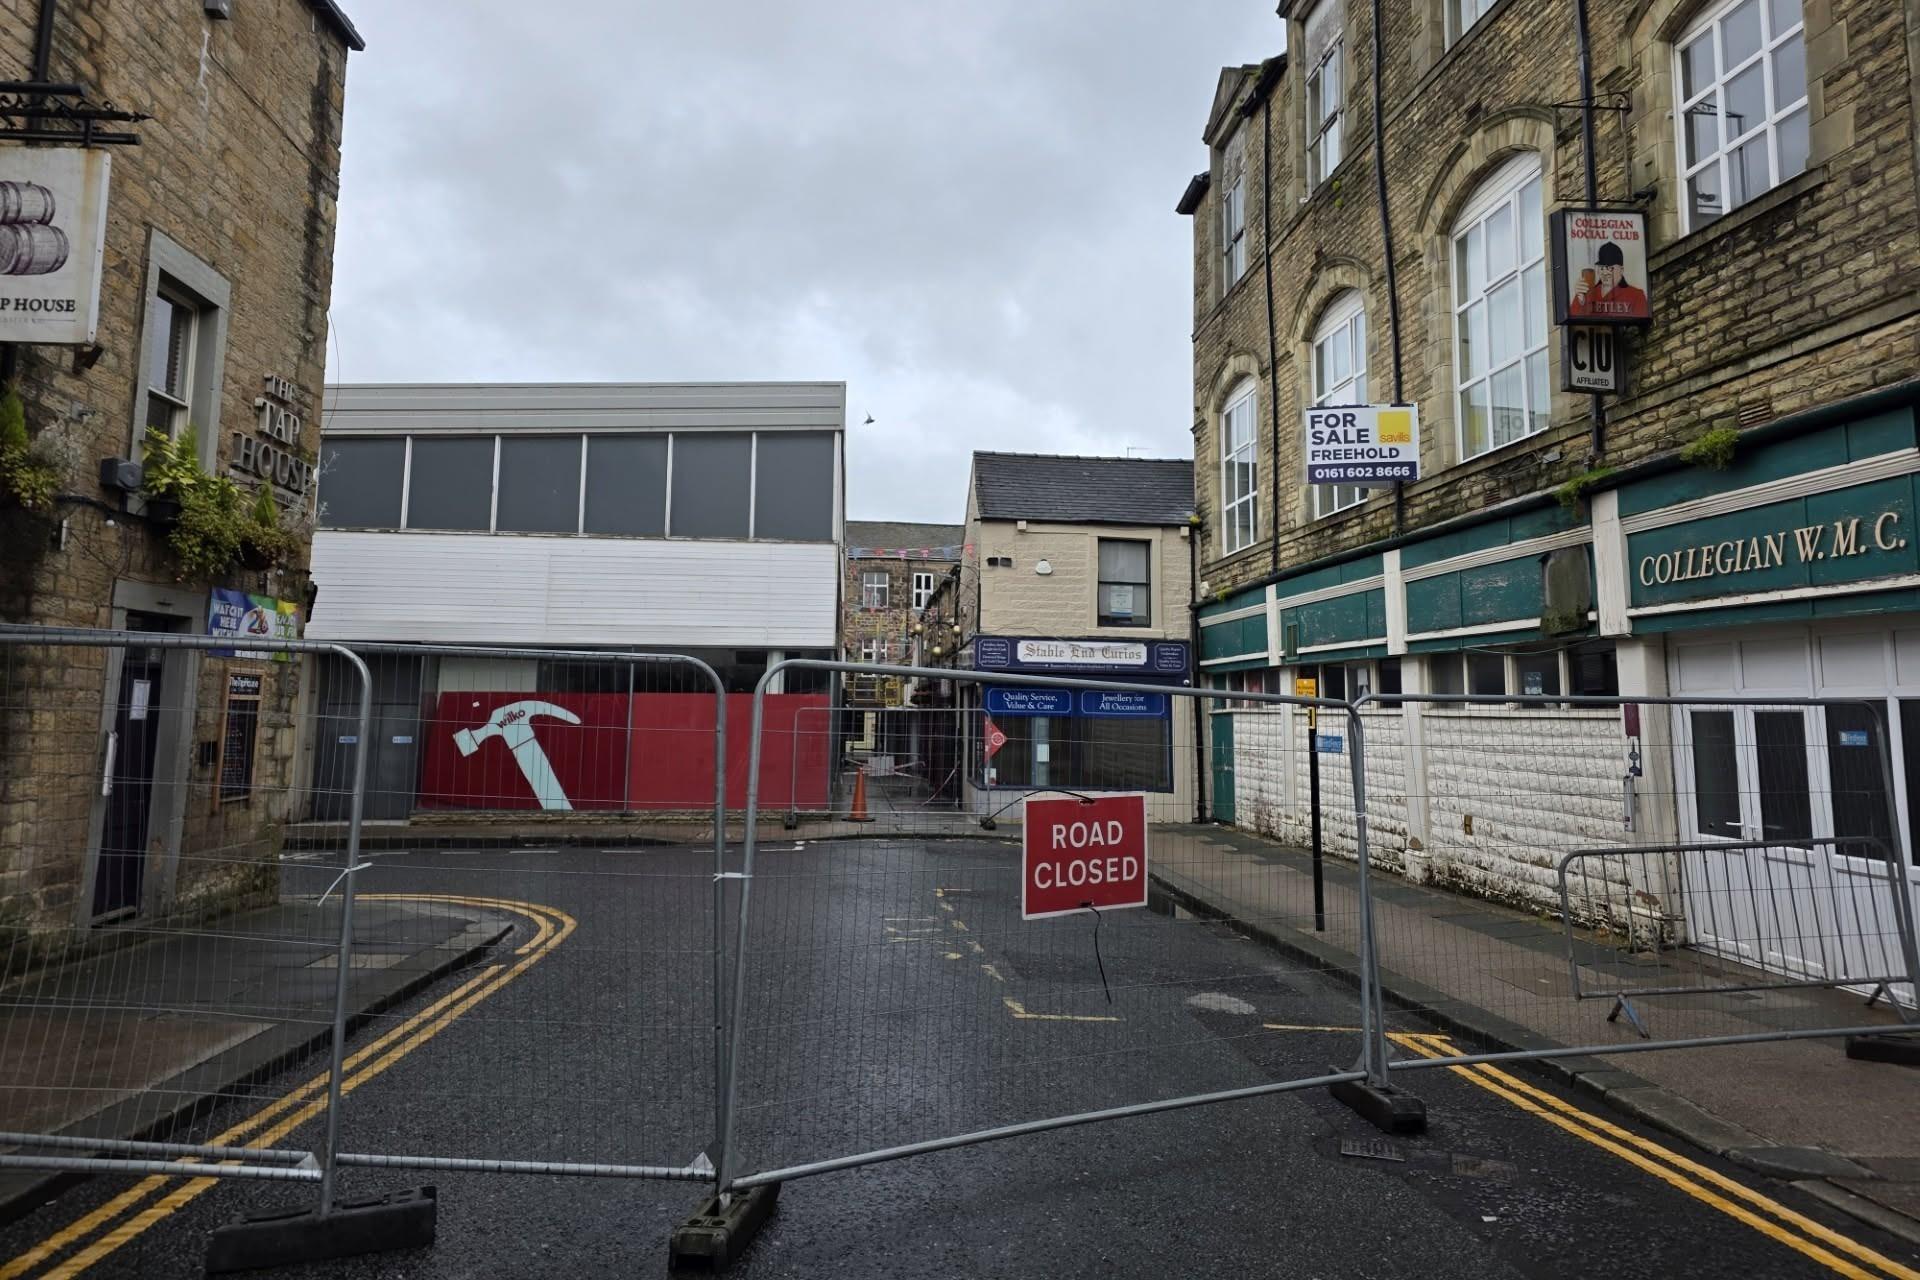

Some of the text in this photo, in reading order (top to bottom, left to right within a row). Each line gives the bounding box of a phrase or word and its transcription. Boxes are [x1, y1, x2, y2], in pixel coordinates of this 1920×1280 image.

[1576, 218, 1633, 229] COLLEGIAN
[1571, 229, 1639, 240] SOCIAL CLUB
[14, 298, 76, 312] HOUSE
[1591, 301, 1632, 313] ETLEY
[1576, 376, 1610, 386] AFFILIATED
[255, 397, 300, 446] TAP
[1310, 413, 1356, 429] FOR
[1311, 429, 1370, 445] SALE
[1311, 447, 1400, 461] FREEHOLD
[232, 431, 313, 494] HOUSE
[1315, 466, 1410, 479] 0161 602 8666
[1639, 532, 1786, 586] COLLEGIAN
[1024, 643, 1065, 658] Stable
[1069, 644, 1096, 659] End
[1101, 645, 1142, 660] Curios
[1003, 693, 1058, 703] Quality Service,
[1102, 693, 1133, 702] Jewellery
[1007, 702, 1054, 710] Value & Care
[1100, 702, 1147, 711] All Occasions
[496, 710, 525, 728] wilko
[1052, 820, 1123, 849] ROAD
[1034, 856, 1138, 889] CLOSED
